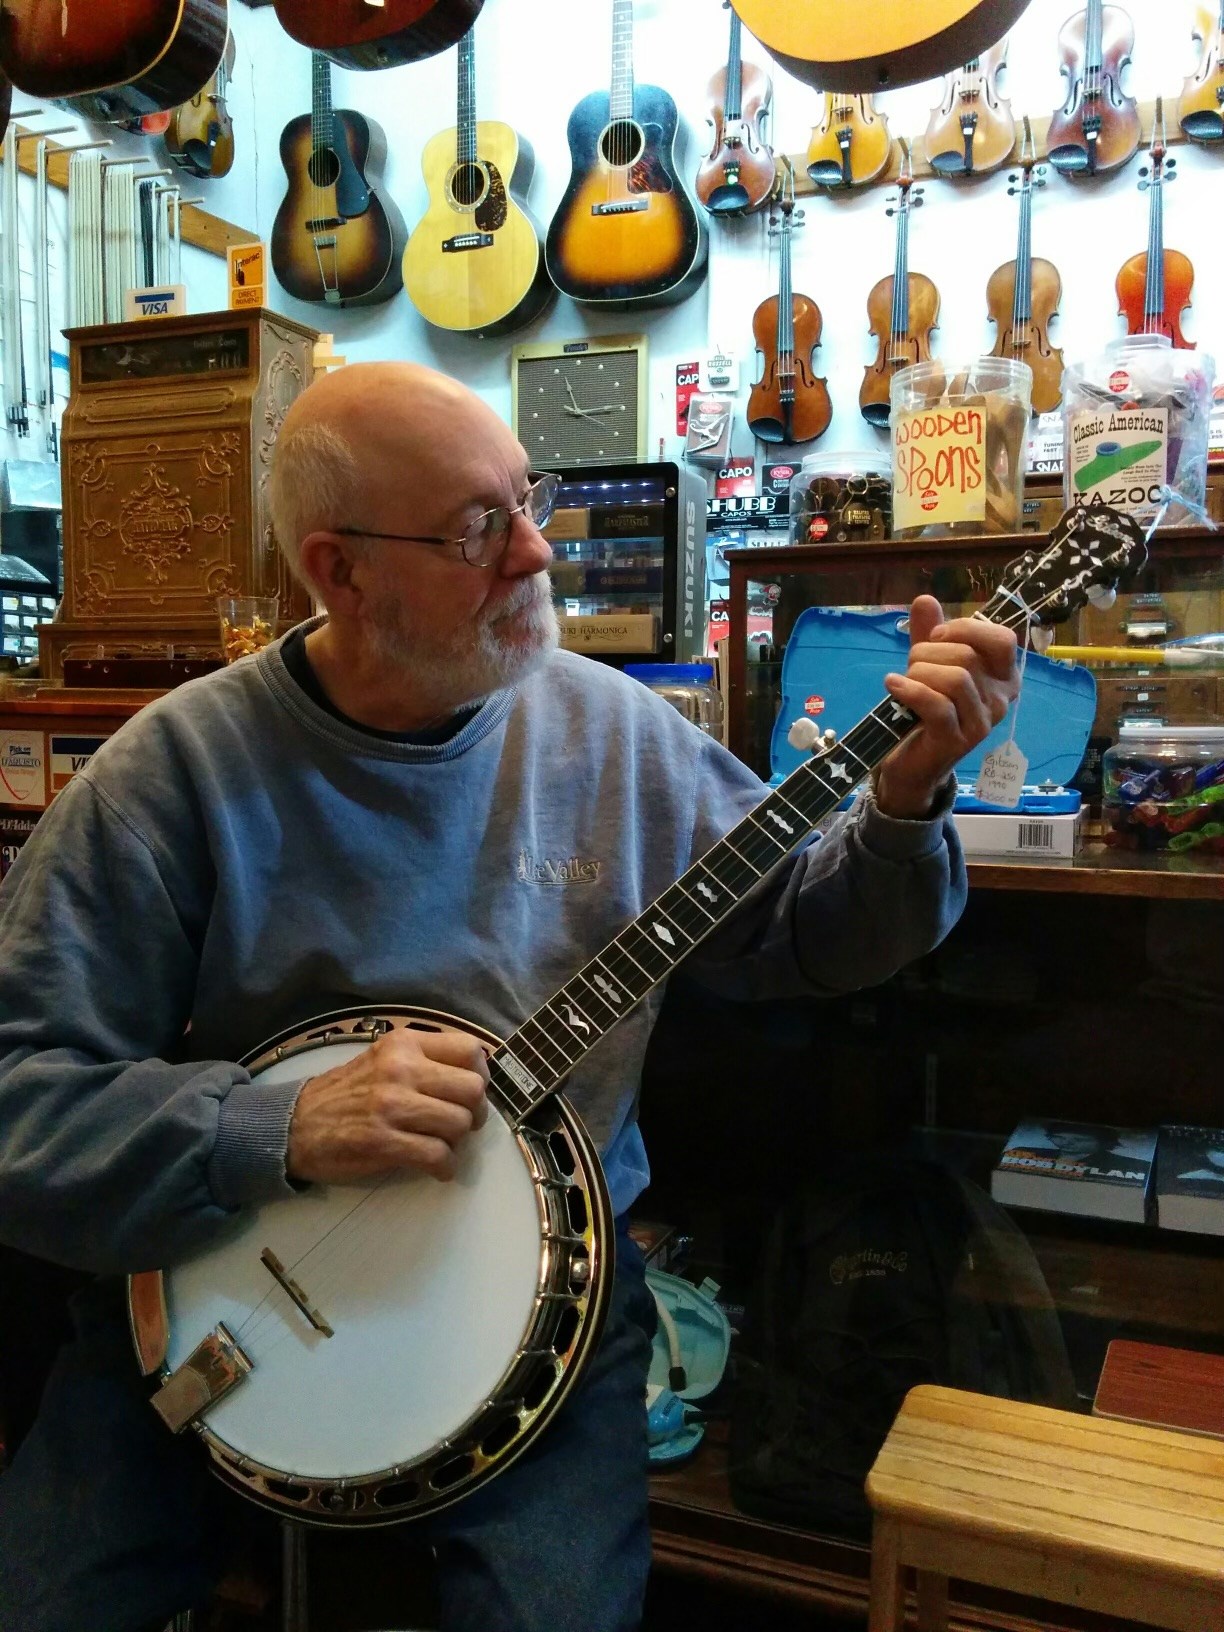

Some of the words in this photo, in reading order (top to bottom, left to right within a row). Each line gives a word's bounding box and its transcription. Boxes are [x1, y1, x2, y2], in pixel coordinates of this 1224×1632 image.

[235, 252, 260, 270] Interac
[235, 295, 260, 305] PAYMENT
[238, 289, 257, 298] DIRECT
[141, 302, 168, 316] VISA
[678, 373, 699, 386] CAP
[1073, 416, 1104, 444] Classic
[1108, 412, 1164, 434] American
[719, 466, 752, 479] CAPO
[684, 501, 696, 638] SUZUKI
[711, 611, 729, 622] CA
[580, 627, 628, 635] HARMONICA
[71, 756, 90, 772] VI
[985, 754, 1018, 769] Gibson
[545, 856, 601, 883] Valley
[504, 1056, 534, 1090] MASTERTONE
[1055, 1163, 1146, 1180] DYLAN
